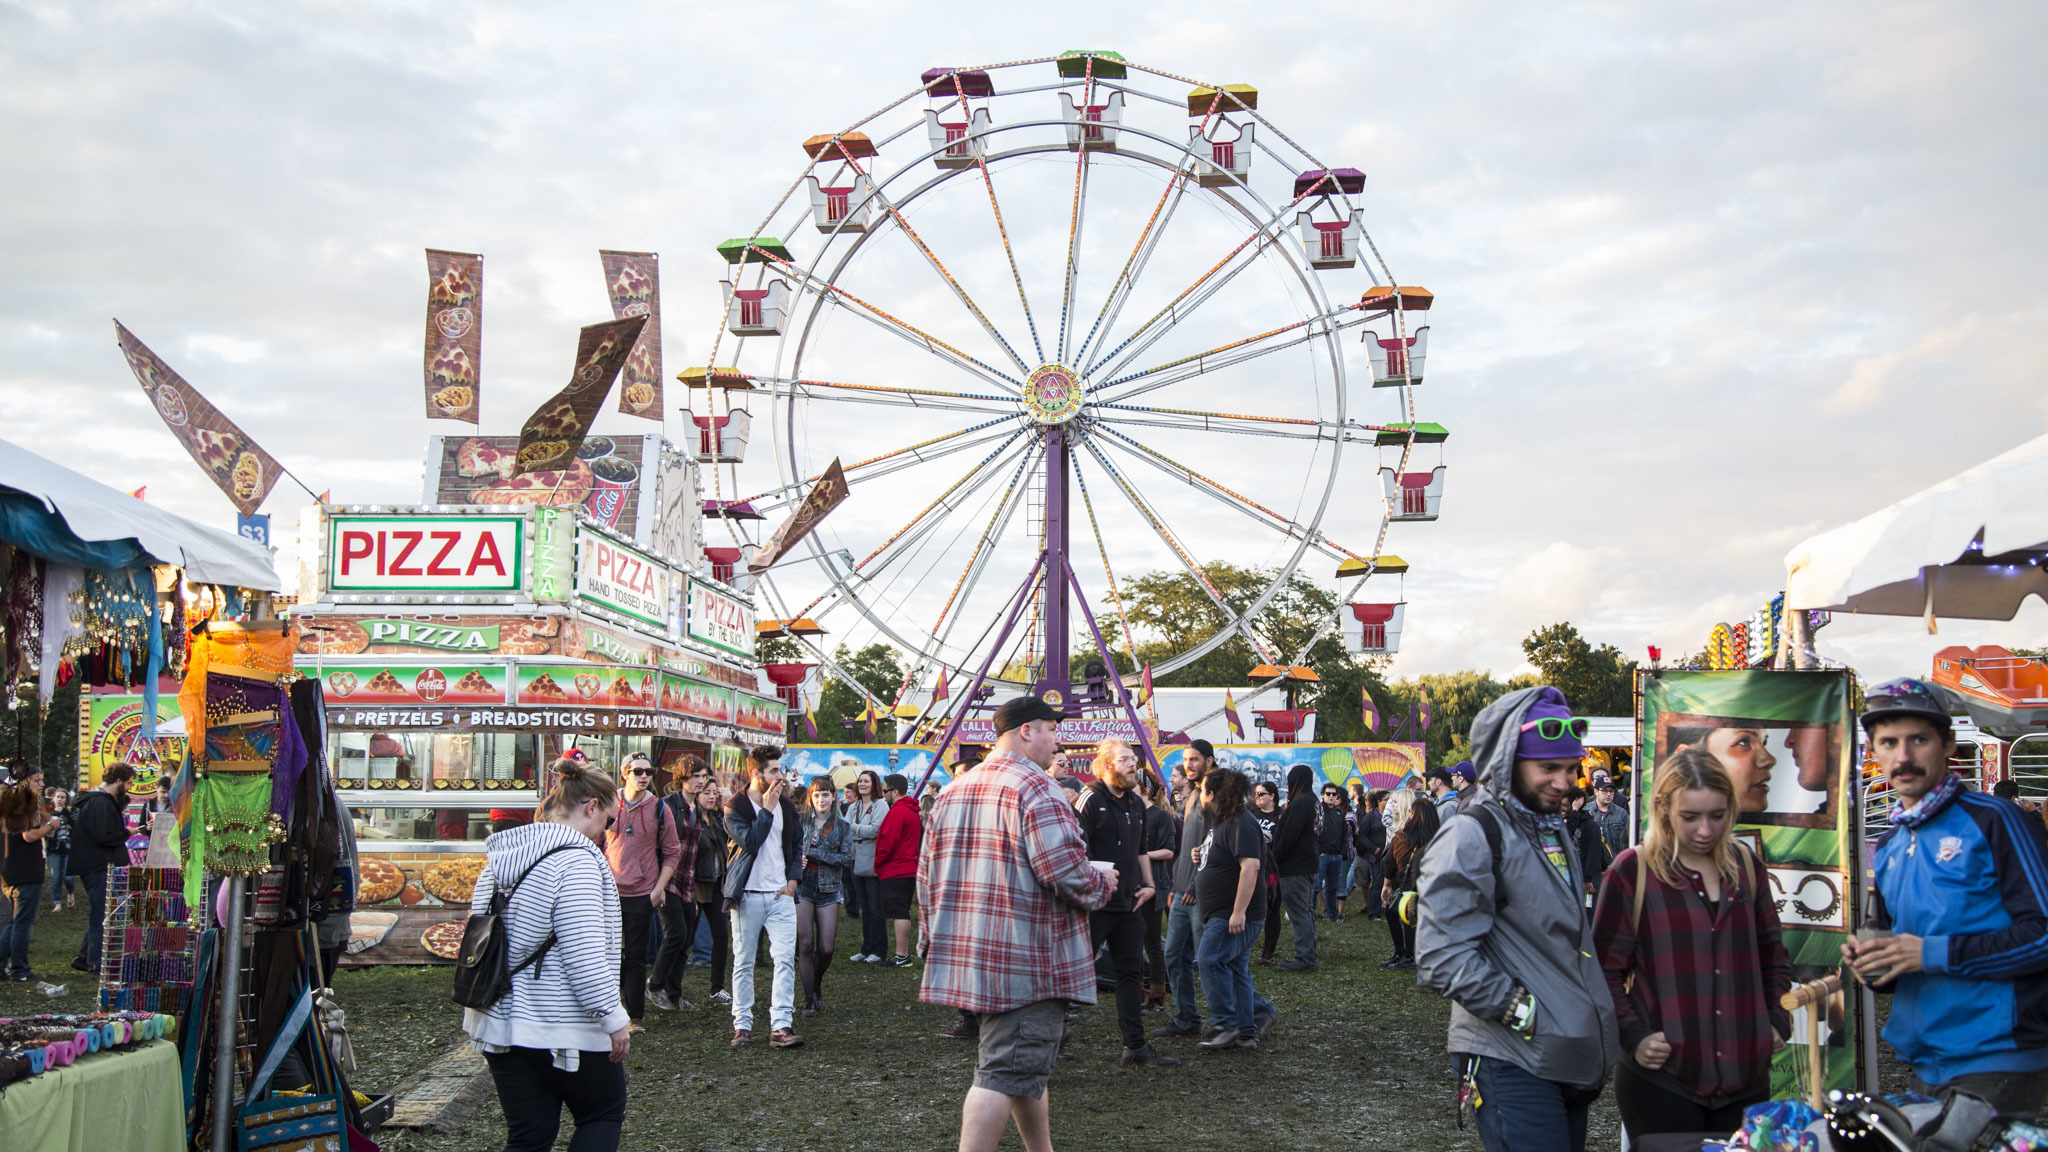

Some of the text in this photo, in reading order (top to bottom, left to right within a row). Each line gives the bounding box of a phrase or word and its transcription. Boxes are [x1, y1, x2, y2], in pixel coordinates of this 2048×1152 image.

[241, 525, 266, 545] S3
[341, 531, 507, 576] PIZZA
[539, 509, 558, 597] PIZZA
[597, 542, 655, 600] PIZZA
[589, 578, 662, 619] HAND TOSSED PIZZA
[704, 590, 746, 635] PIZZA
[372, 622, 489, 649] PIZZA
[708, 622, 715, 637] BY
[718, 626, 727, 642] THE
[592, 632, 640, 664] PIZZA
[354, 711, 443, 726] PRETZELS
[470, 711, 596, 727] BREADSTICKS
[617, 713, 652, 729] PIZZA
[961, 721, 988, 732] CALL
[1061, 721, 1088, 732] NEXT
[966, 732, 982, 741] and
[1066, 732, 1105, 743] Signing
